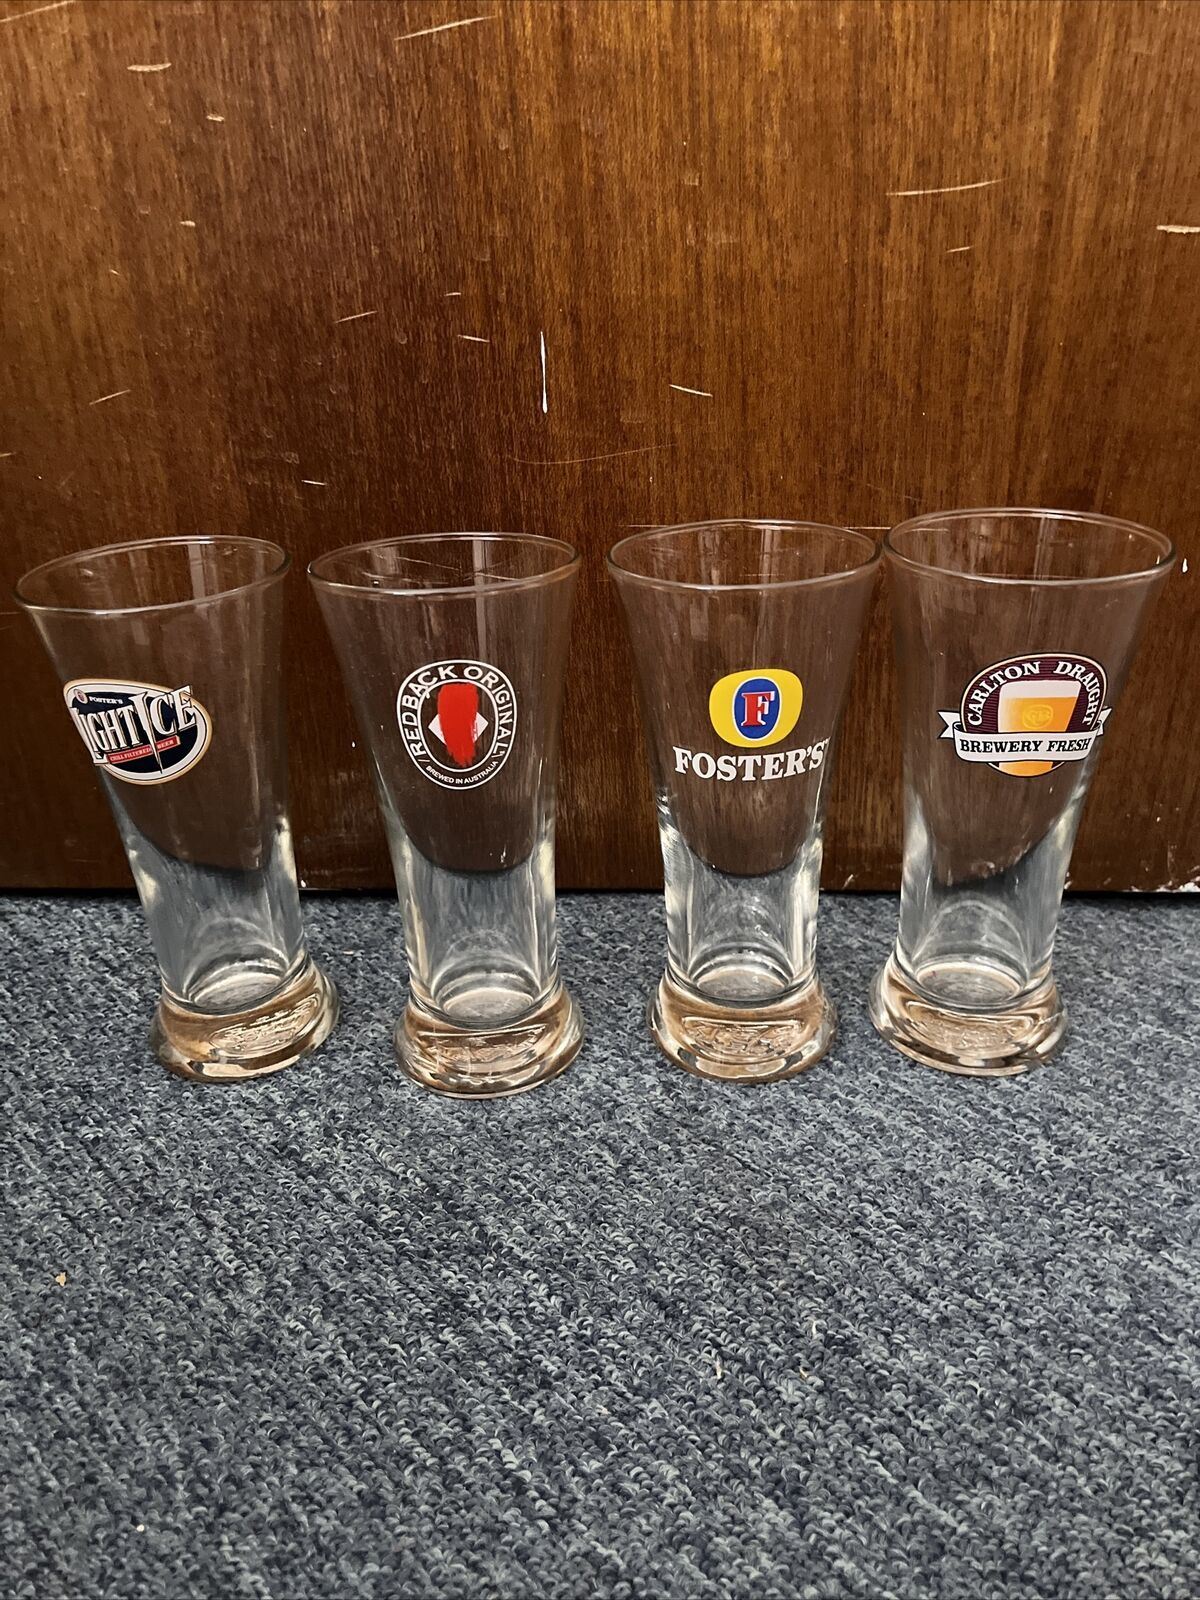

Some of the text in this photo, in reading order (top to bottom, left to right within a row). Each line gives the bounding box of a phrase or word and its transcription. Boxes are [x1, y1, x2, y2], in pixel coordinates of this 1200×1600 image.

[401, 665, 512, 757] REDBACK ORIGINAL
[741, 691, 775, 726] F
[967, 661, 1100, 726] CARLTON DRAUGHT
[128, 685, 197, 773] ICE
[959, 737, 1092, 753] BREWERY FRESH
[425, 765, 455, 784] BREWED
[463, 761, 499, 784] AUSTRALIA
[672, 741, 825, 782] FOSTER'S
